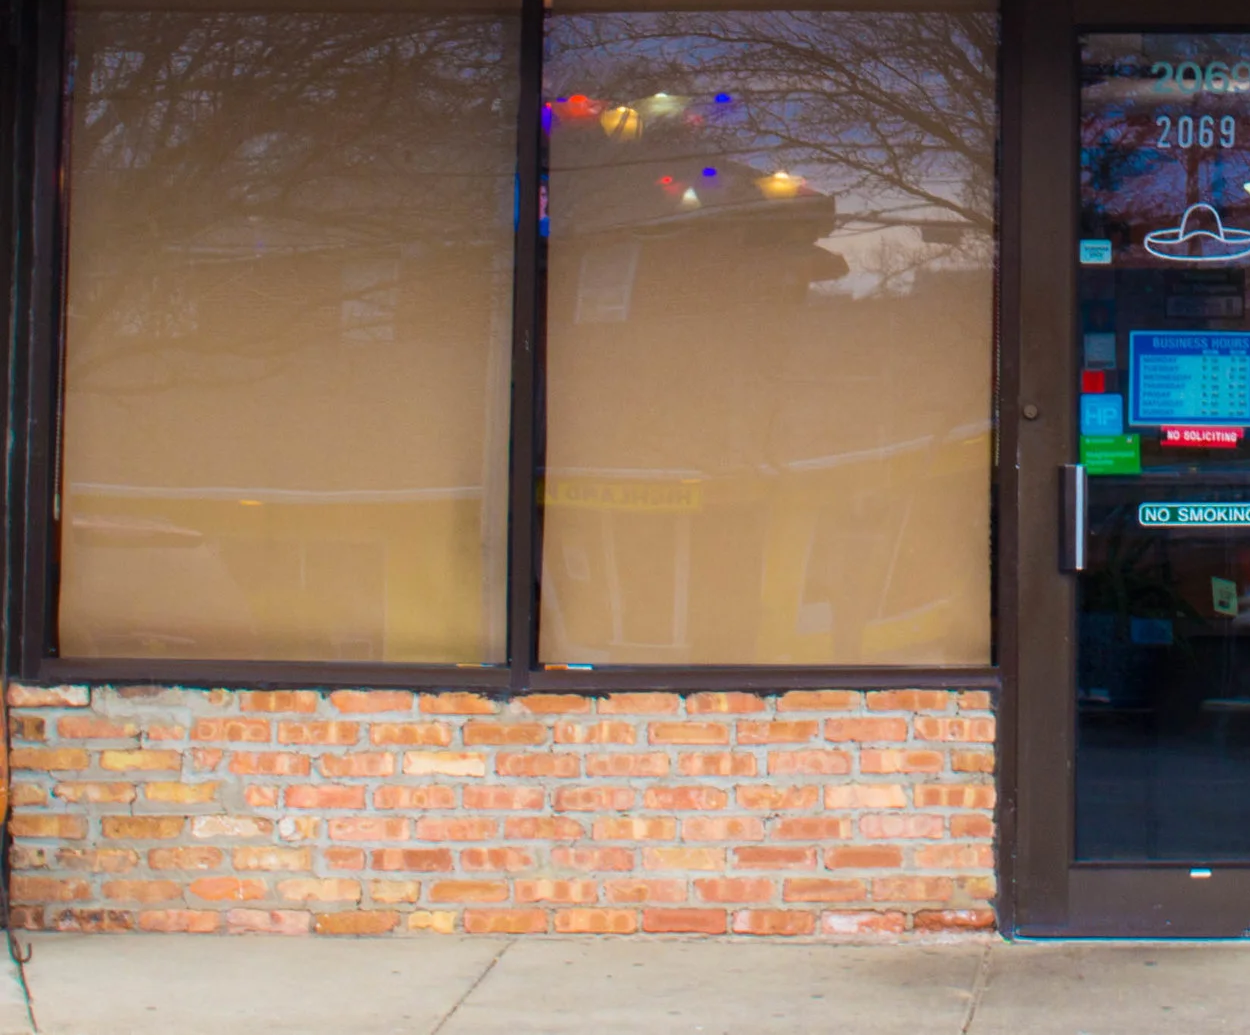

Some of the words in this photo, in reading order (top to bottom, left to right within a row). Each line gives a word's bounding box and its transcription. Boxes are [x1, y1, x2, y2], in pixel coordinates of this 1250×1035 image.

[1156, 115, 1236, 148] 2069
[1152, 337, 1209, 350] BUSINESS
[1211, 337, 1250, 350] HOURS
[1167, 430, 1180, 441] NO
[1183, 431, 1237, 443] SOLICITING
[1144, 508, 1170, 522] NO
